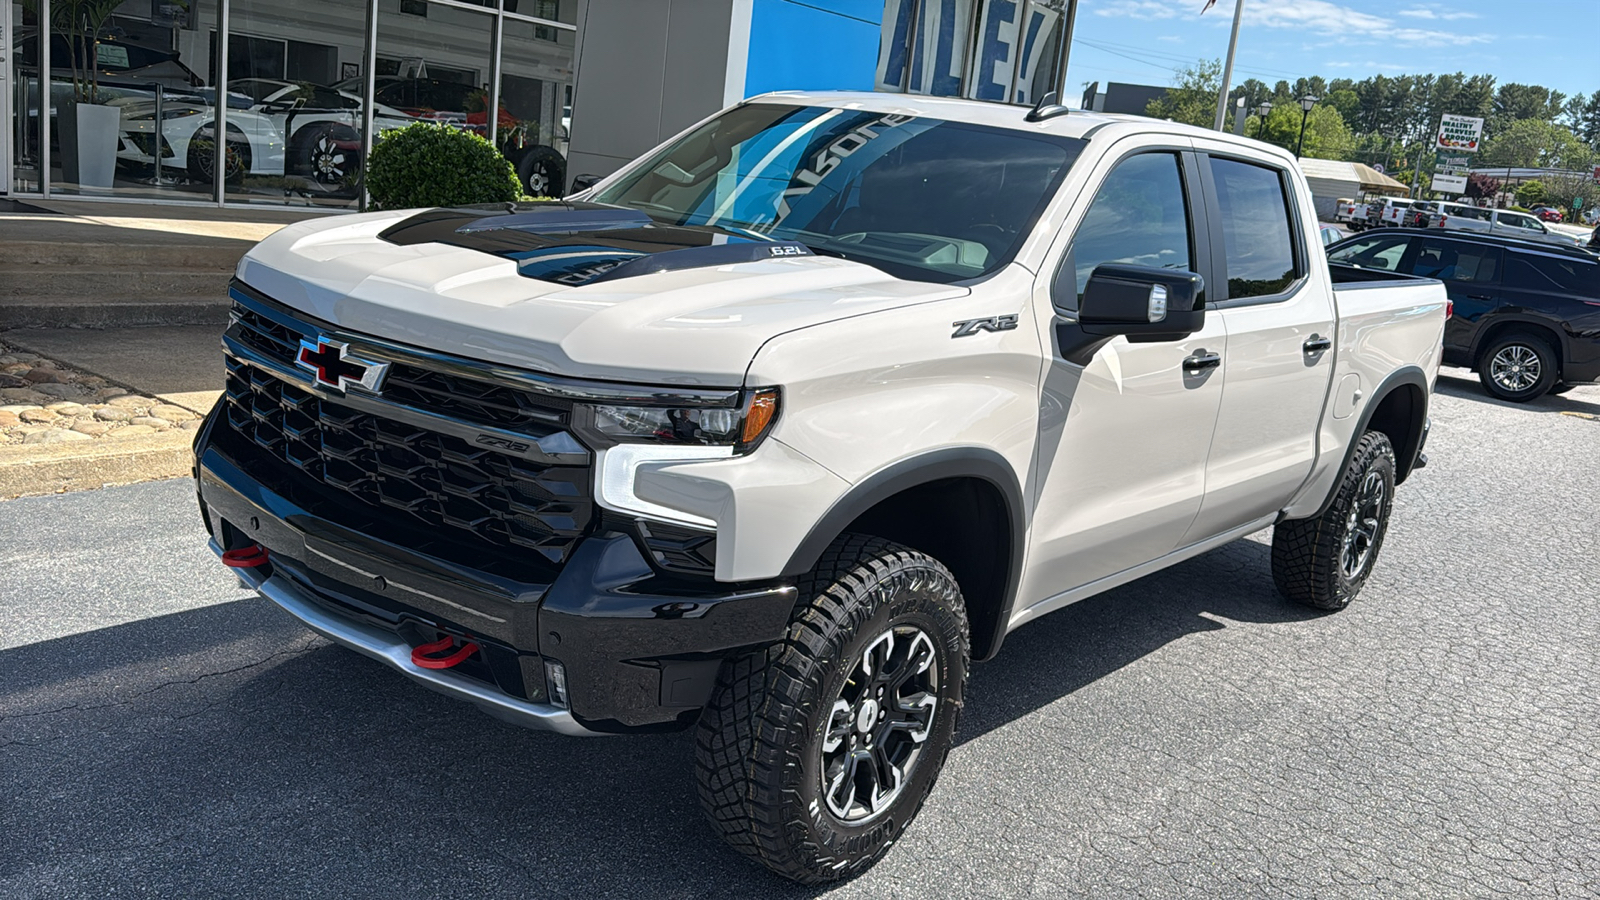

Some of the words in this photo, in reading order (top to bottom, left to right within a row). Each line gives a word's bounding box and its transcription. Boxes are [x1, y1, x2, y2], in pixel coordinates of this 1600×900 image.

[1442, 121, 1473, 129] HEALTHY
[1444, 128, 1477, 136] HARVEST
[1445, 134, 1479, 142] PRODUCE
[771, 246, 807, 256] 6.2L
[951, 313, 1019, 339] ZR2
[476, 433, 530, 453] ZR2
